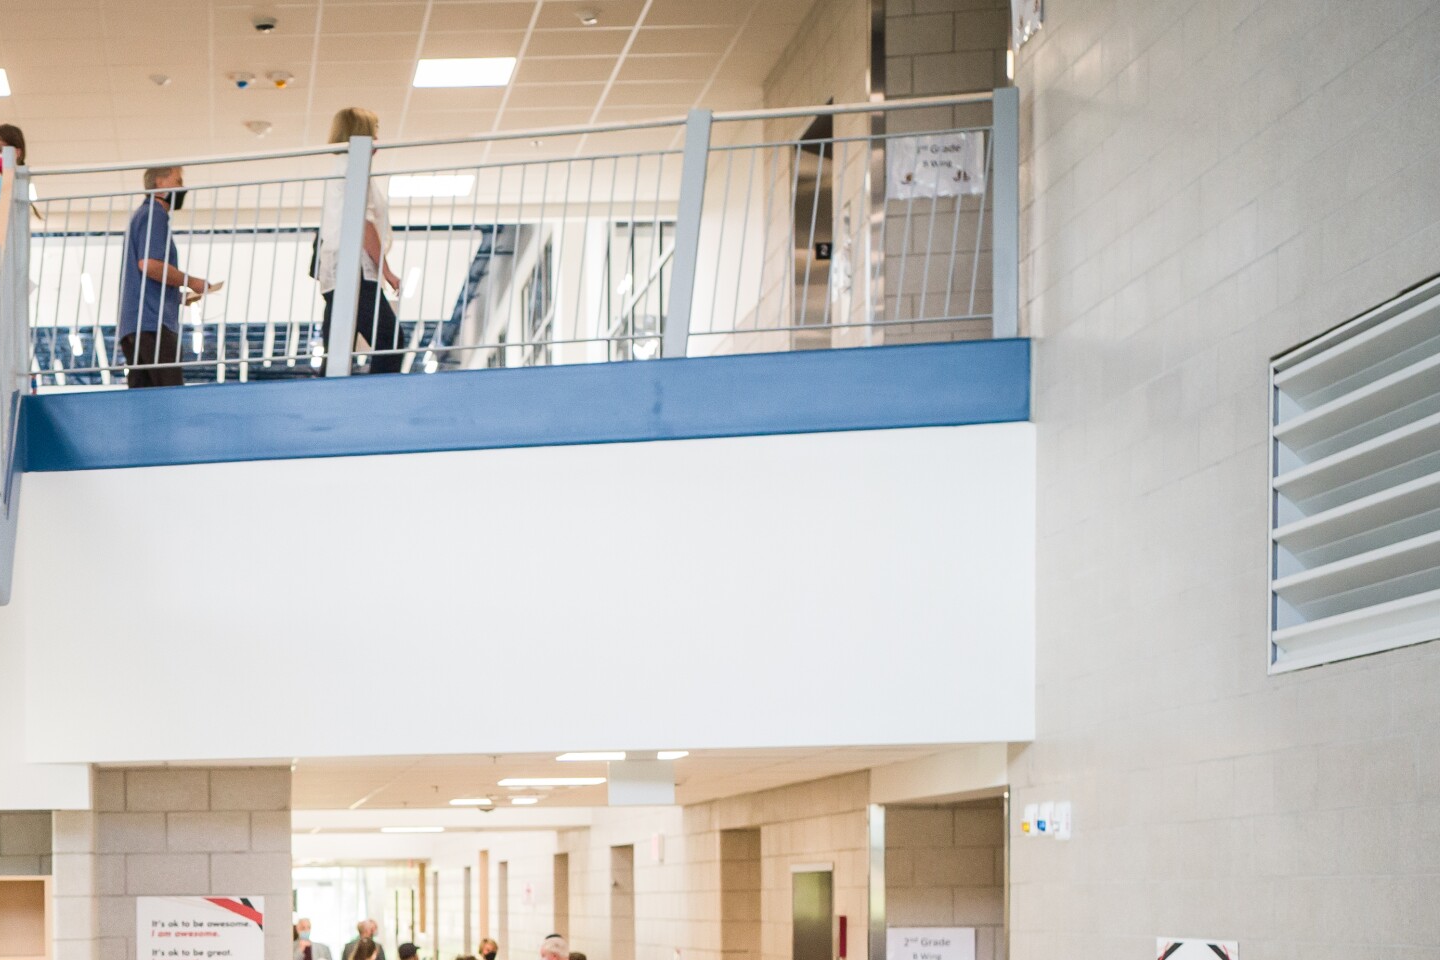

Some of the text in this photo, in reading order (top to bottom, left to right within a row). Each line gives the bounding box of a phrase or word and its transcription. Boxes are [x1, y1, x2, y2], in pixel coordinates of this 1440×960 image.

[151, 920, 165, 928] It's
[168, 920, 178, 928] ok
[181, 920, 190, 928] to
[193, 920, 204, 928] be
[920, 937, 951, 948] Grade
[151, 949, 232, 958] It's ok to be great.
